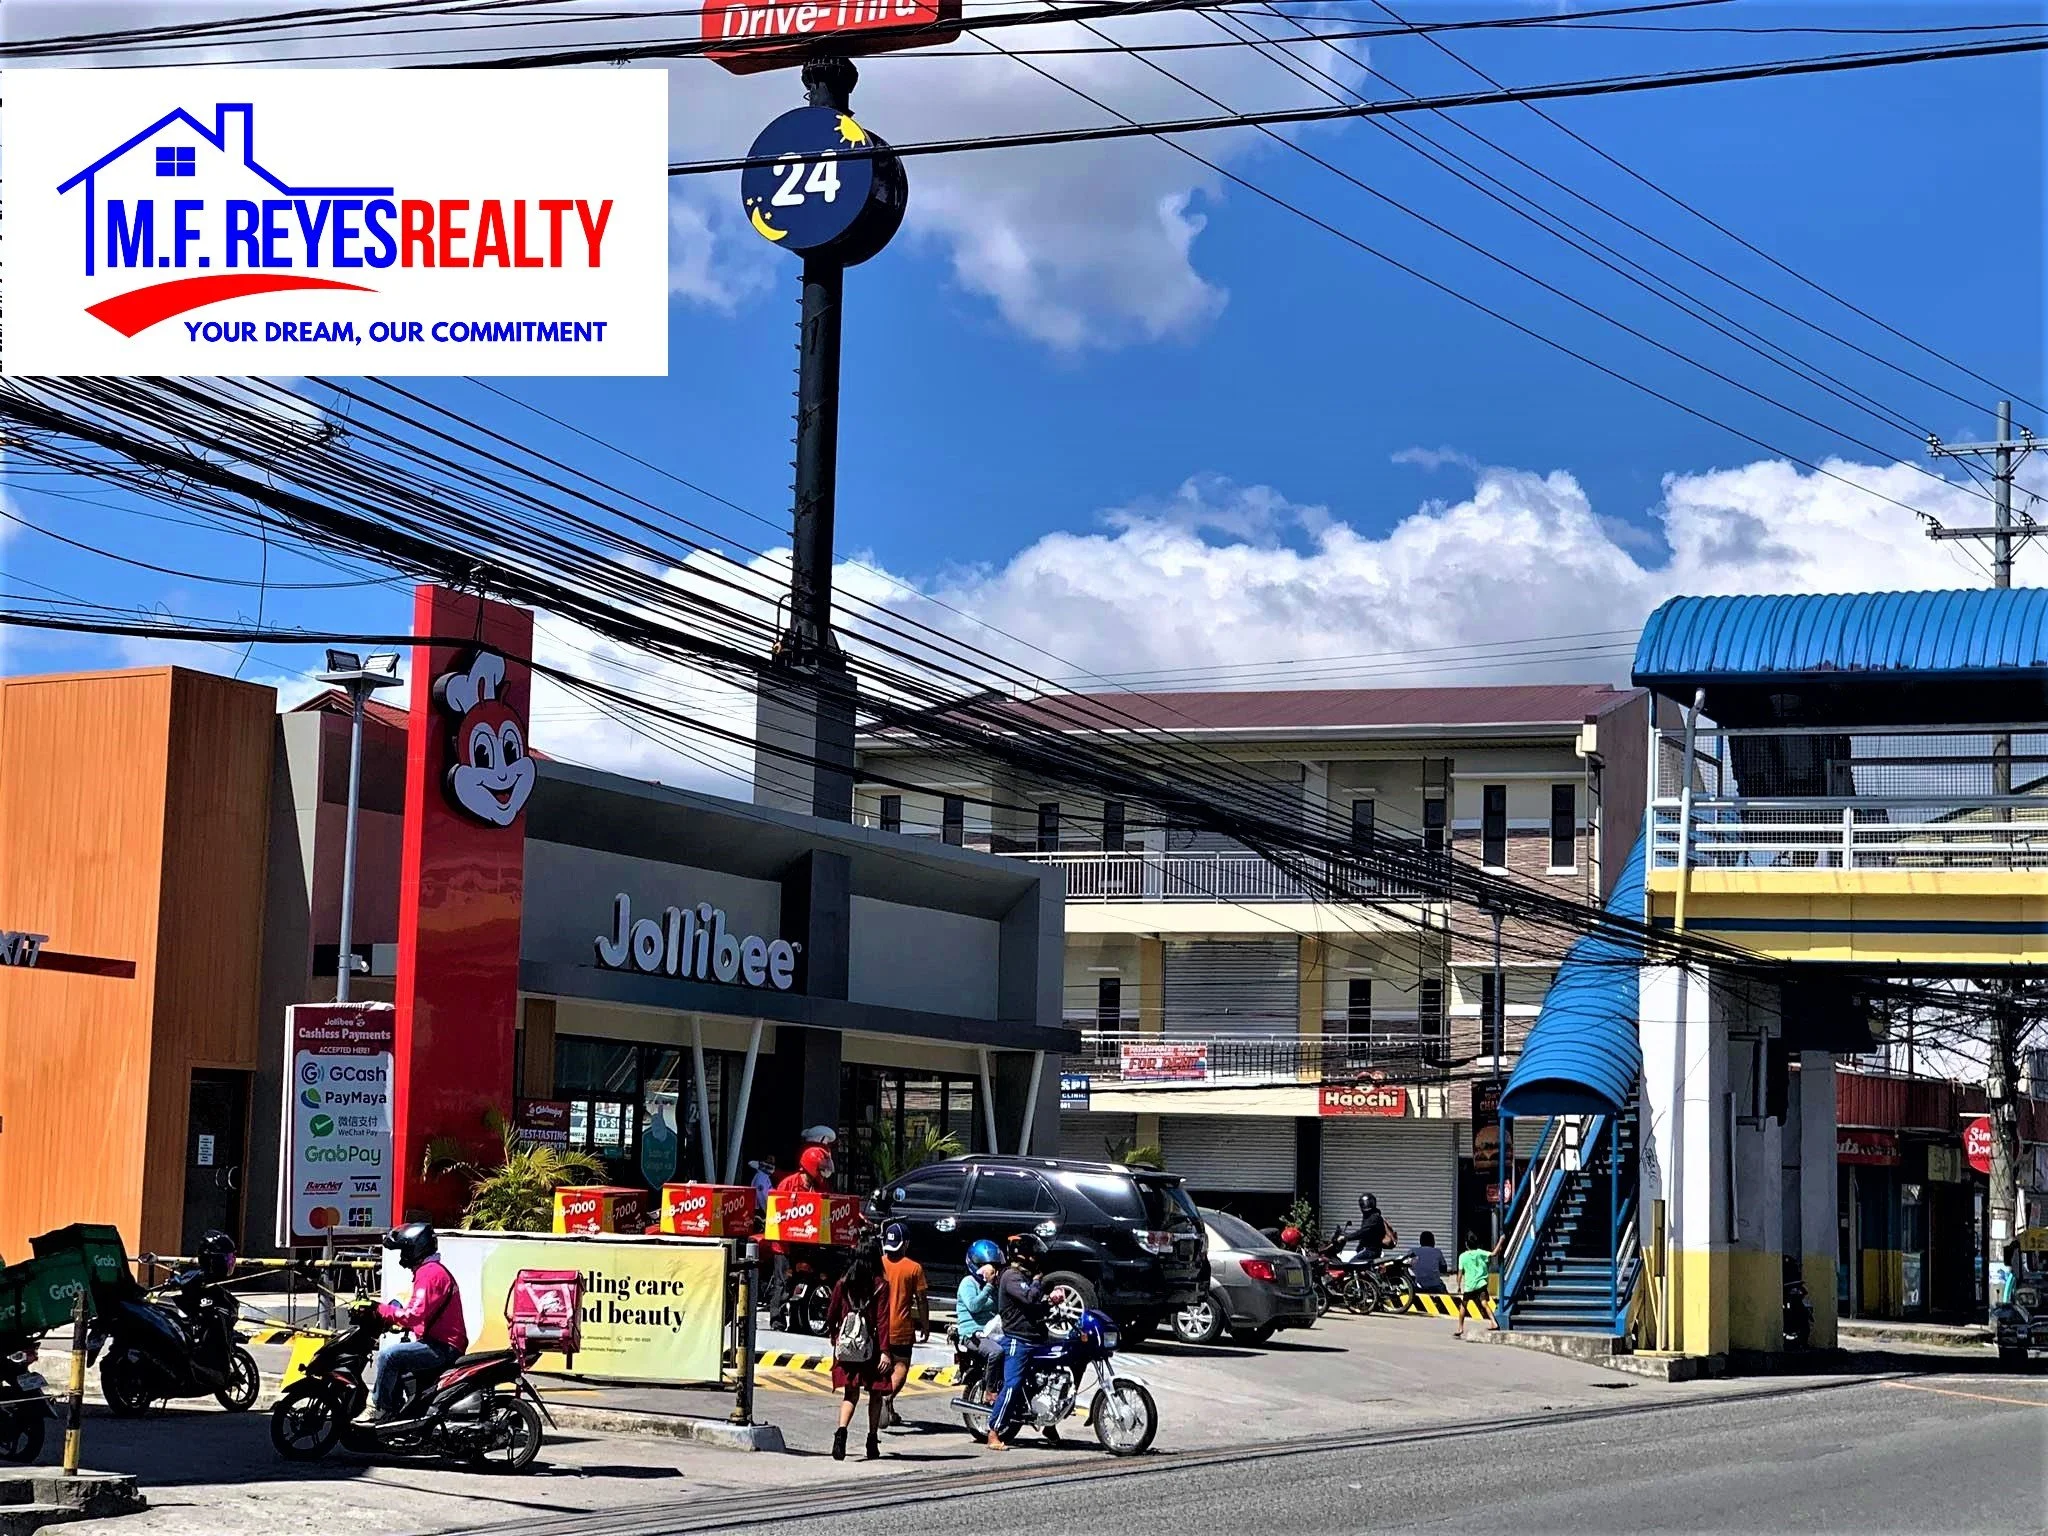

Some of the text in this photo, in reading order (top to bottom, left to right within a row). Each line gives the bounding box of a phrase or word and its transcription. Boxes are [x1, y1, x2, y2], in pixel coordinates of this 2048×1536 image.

[771, 149, 841, 207] 24
[594, 893, 796, 989] Jollibee
[299, 1027, 391, 1042] Cashless Payments
[319, 1046, 352, 1054] ACCEPTED
[329, 1066, 387, 1081] GCash
[325, 1091, 387, 1105] PayMaya
[338, 1128, 378, 1137] WeChat Pay
[304, 1144, 381, 1166] GrabPay
[354, 1182, 378, 1192] VISA
[94, 1255, 116, 1267] Grab
[49, 1279, 84, 1300] Grab
[635, 1279, 685, 1296] care
[608, 1300, 686, 1333] beauty
